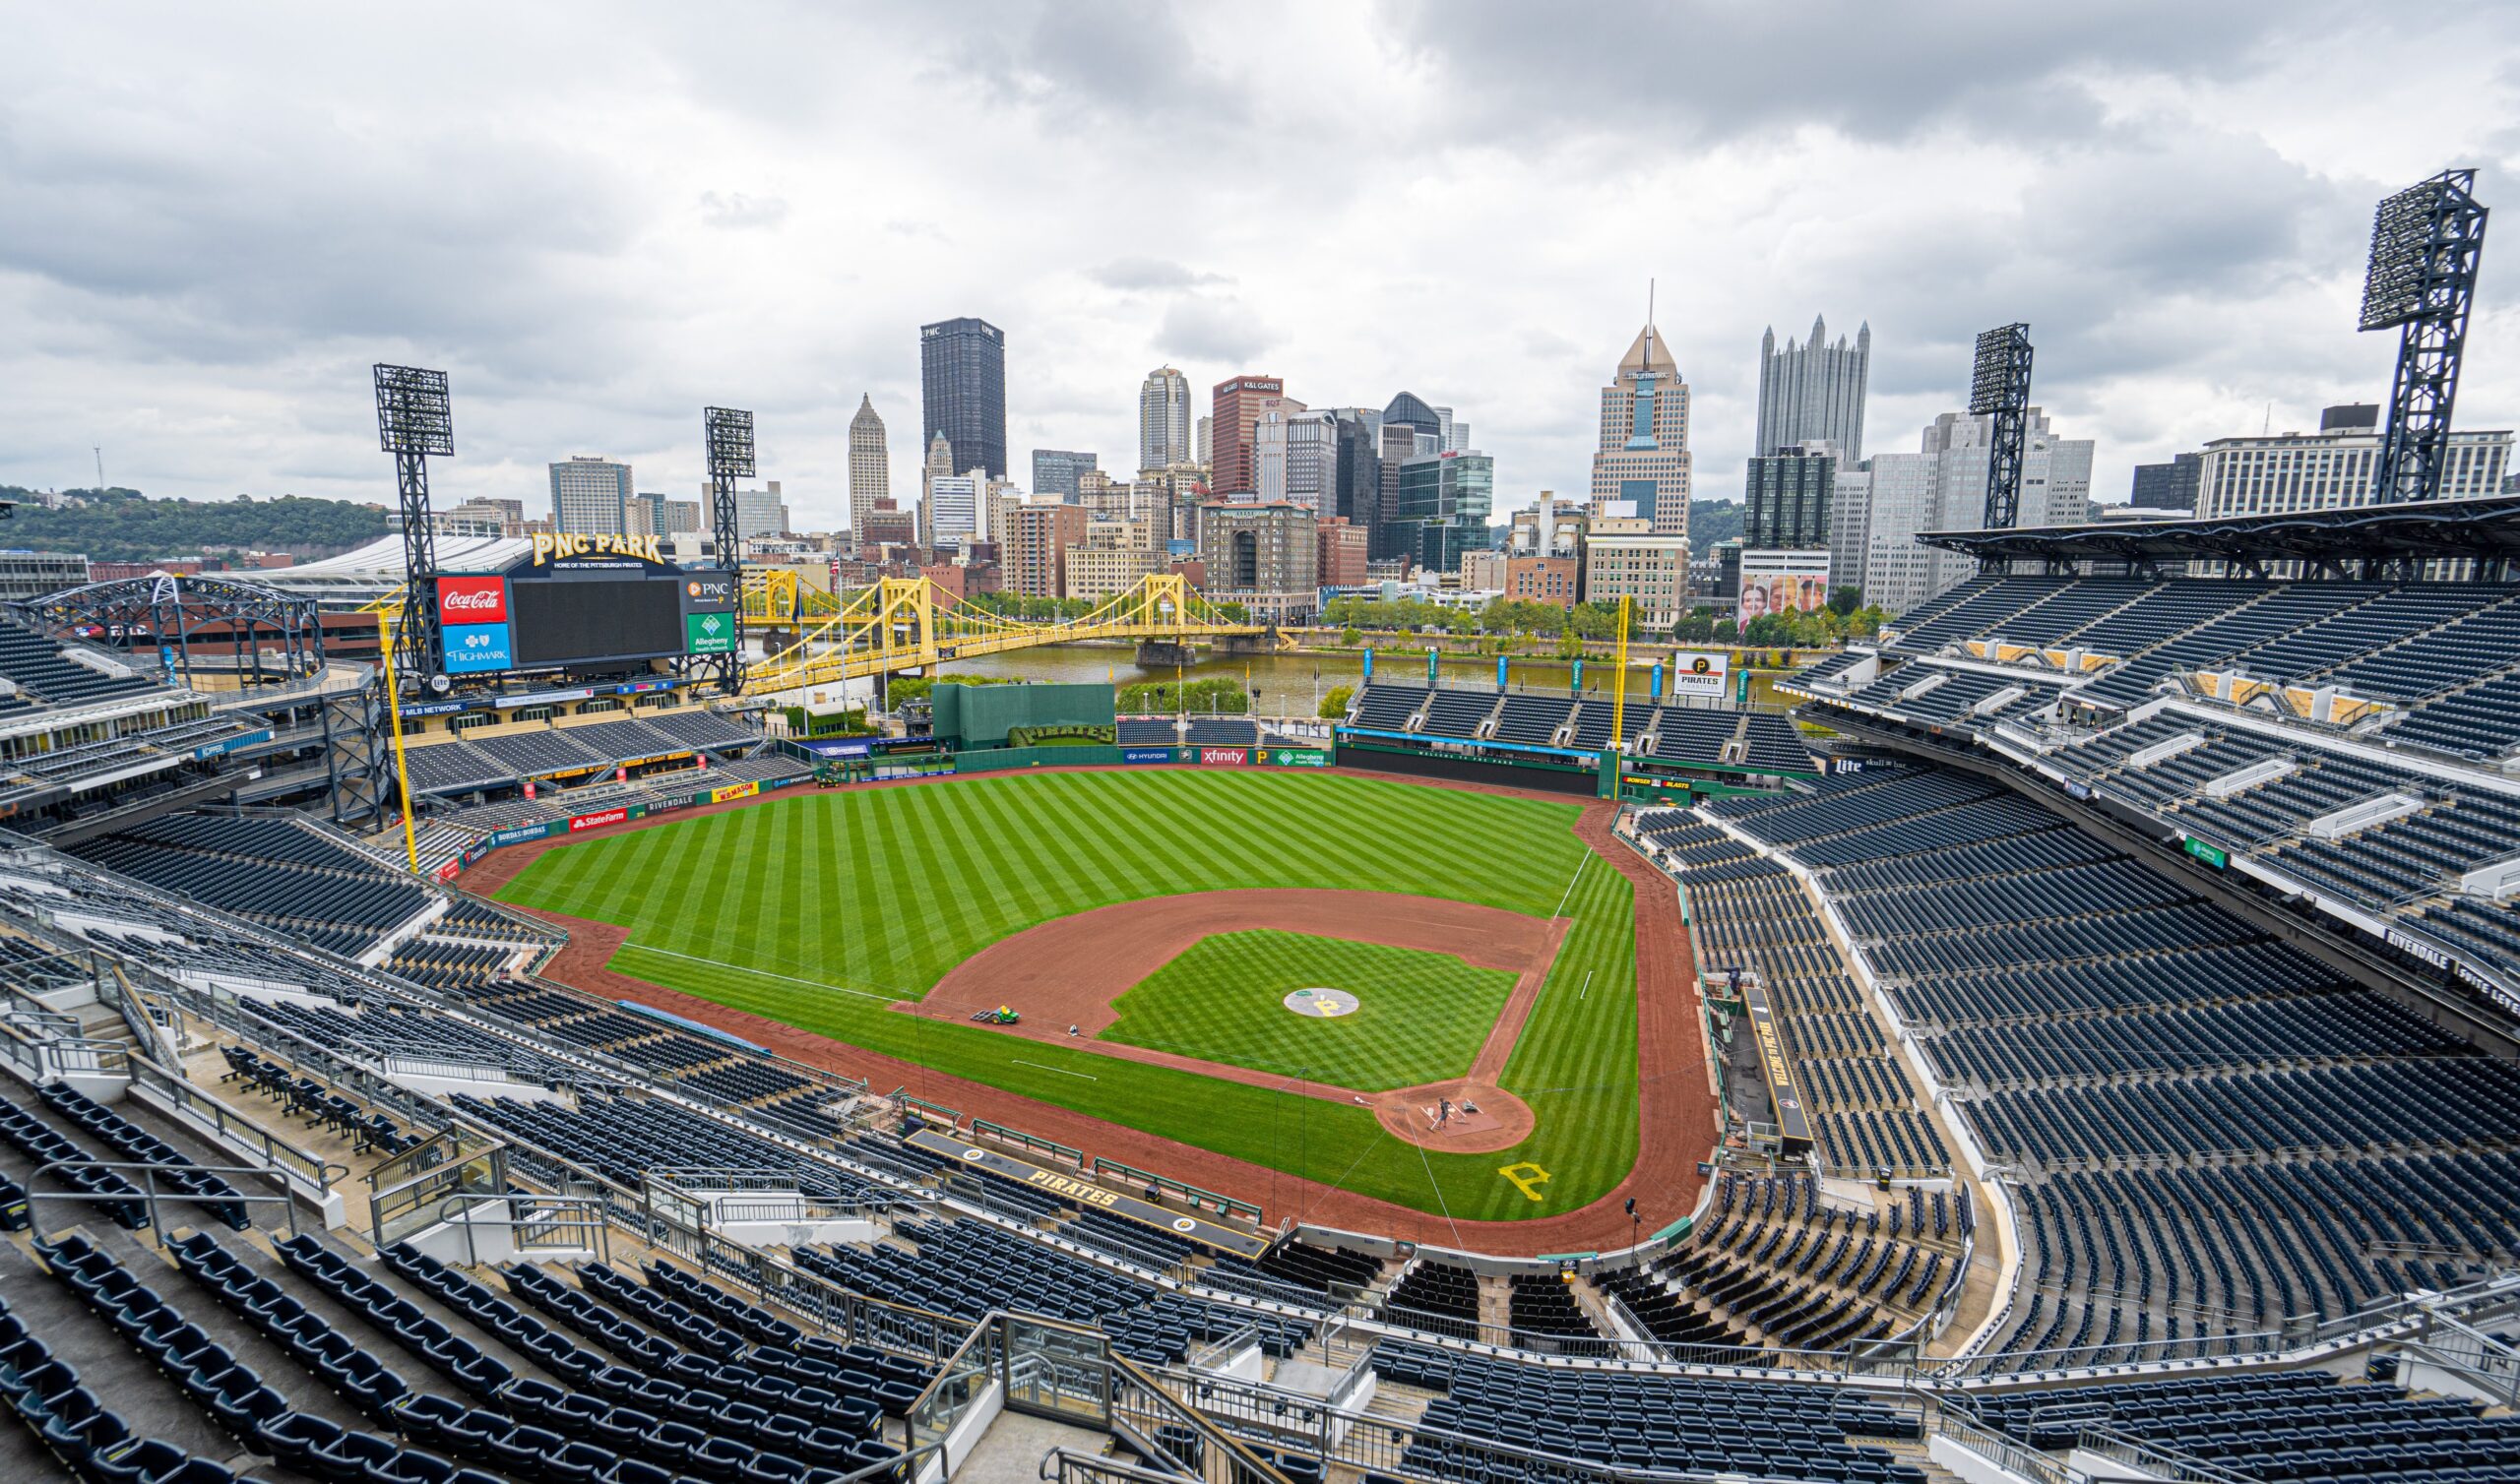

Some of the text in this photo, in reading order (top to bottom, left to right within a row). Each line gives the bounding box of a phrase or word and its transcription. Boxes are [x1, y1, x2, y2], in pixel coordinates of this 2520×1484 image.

[1257, 382, 1280, 391] GATES
[532, 532, 664, 567] PNC PARK
[702, 583, 728, 594] PNC
[695, 637, 728, 647] Allegheny
[1696, 660, 1706, 672] P
[433, 678, 447, 688] Lite
[1681, 676, 1718, 685] PIRATES
[406, 704, 462, 716] MLB NETWORK
[1204, 749, 1244, 764] xfinity
[1865, 758, 1884, 767] skull
[1835, 759, 1862, 774] Lite
[1667, 780, 1689, 789] BLASTS
[649, 794, 693, 811] RIVENDALE
[498, 831, 521, 841] BORDAS
[523, 826, 545, 836] BORDAS
[2387, 931, 2449, 970] RIVENDALE
[2459, 968, 2520, 1019] SUITE LEVE
[1027, 1170, 1119, 1206] PIRATES
[1498, 1161, 1551, 1202] P
